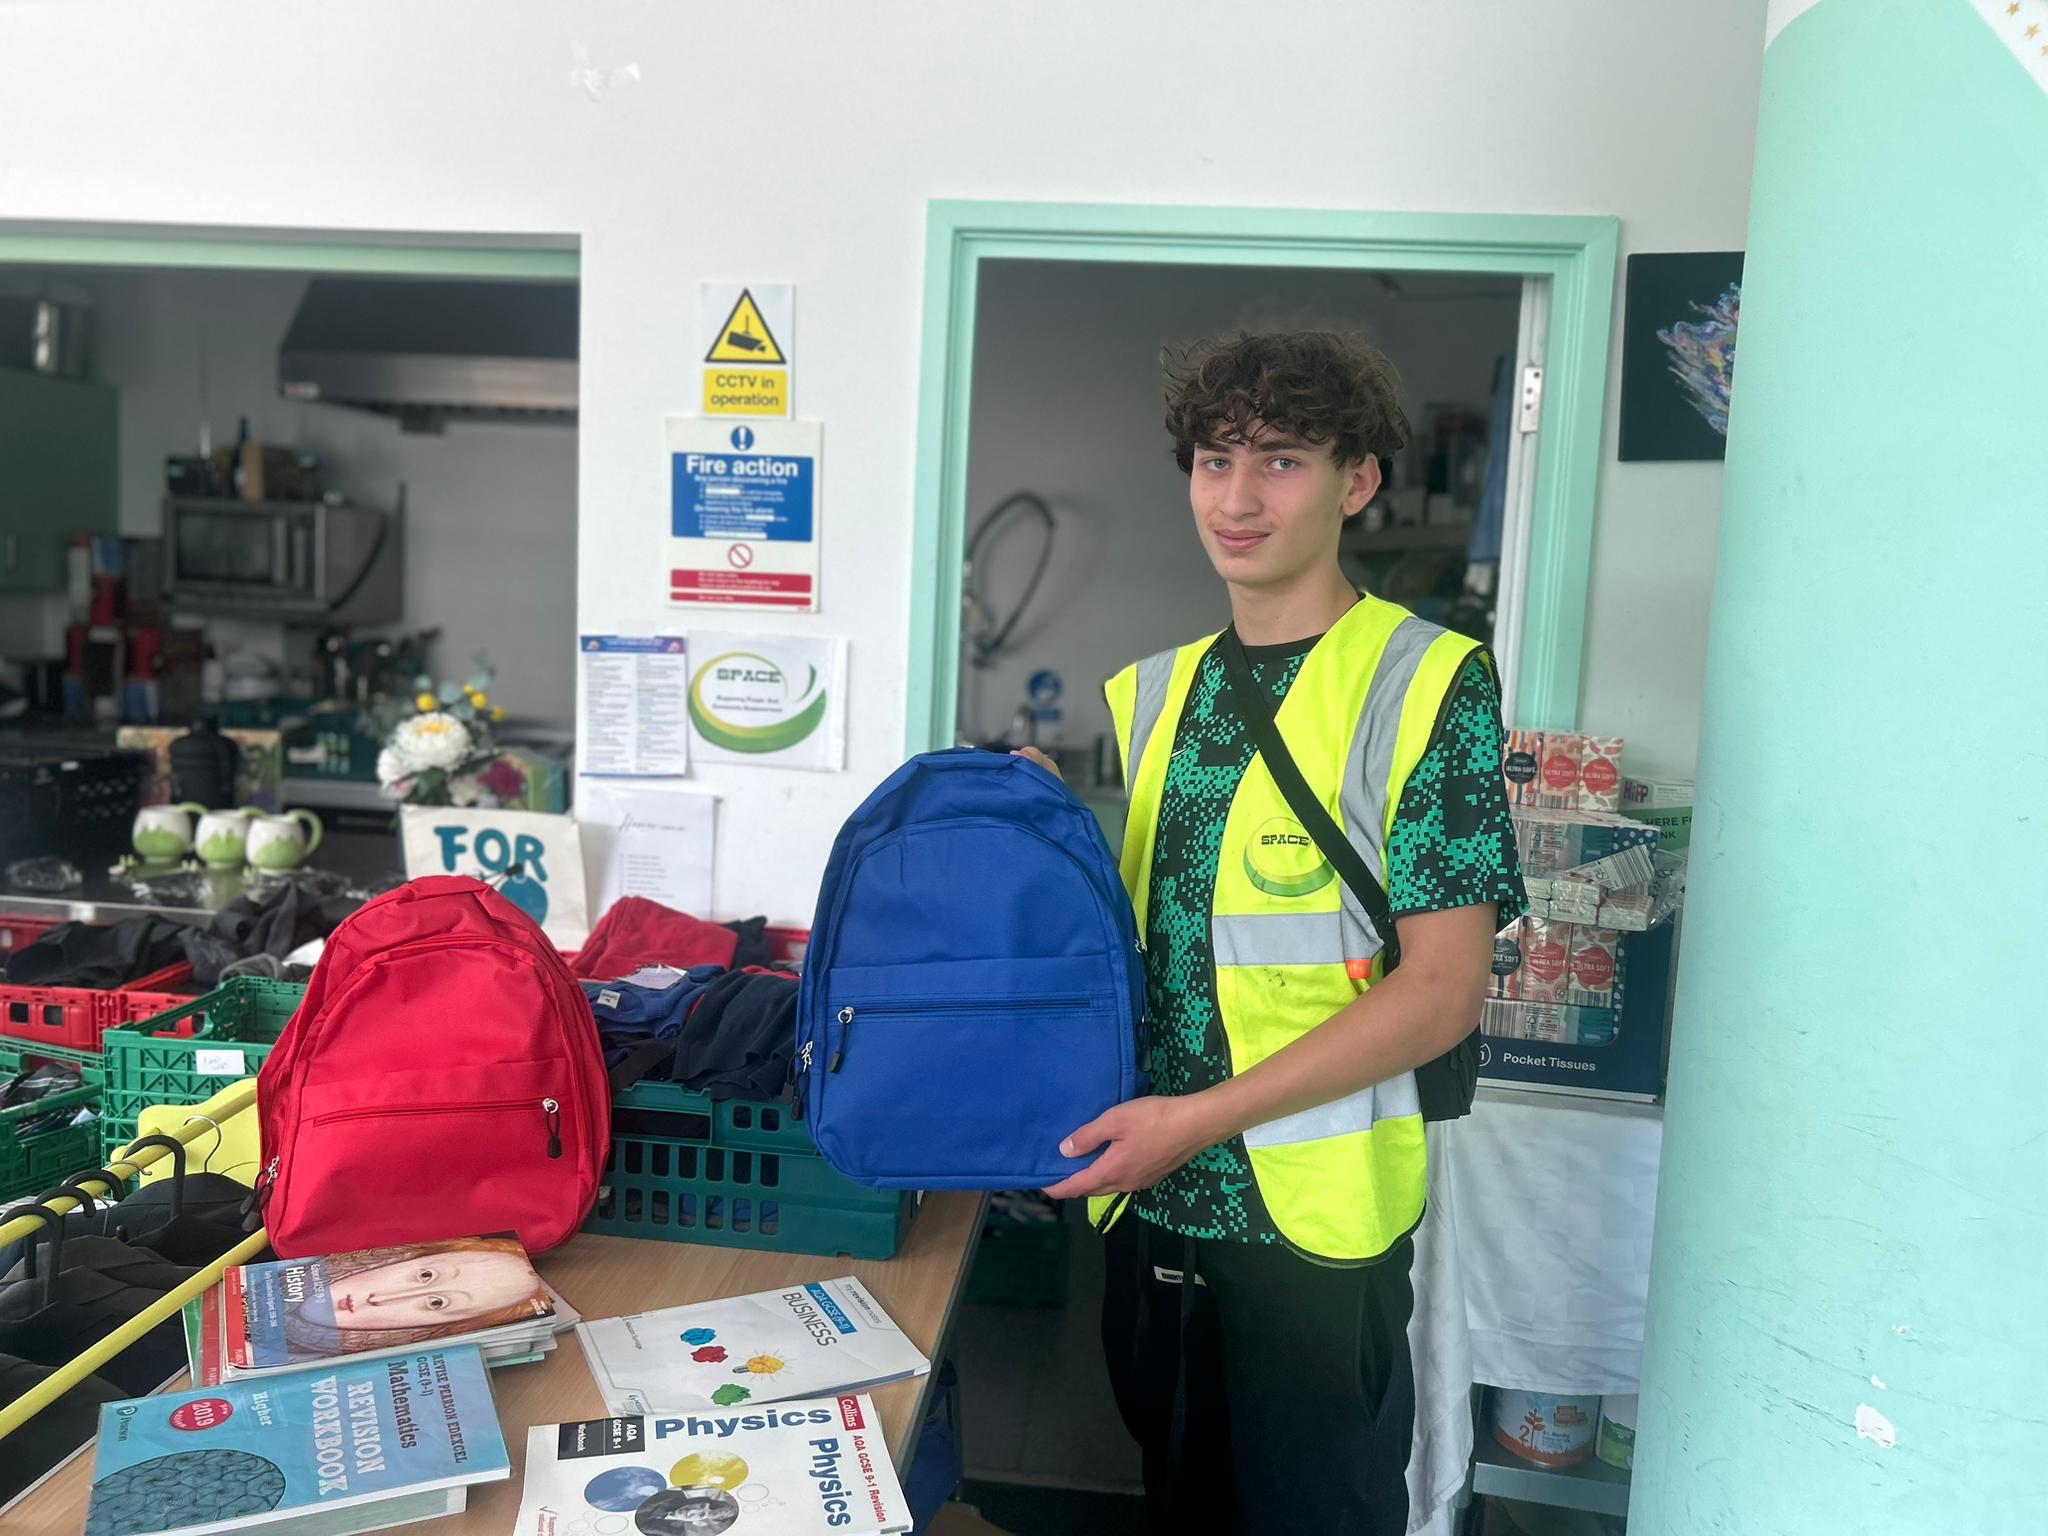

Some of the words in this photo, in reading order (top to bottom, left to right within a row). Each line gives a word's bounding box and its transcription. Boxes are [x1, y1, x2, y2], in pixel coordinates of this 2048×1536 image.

[715, 375, 757, 388] CCTV
[761, 376, 775, 388] in
[711, 393, 780, 407] operation
[686, 455, 727, 475] Fire
[732, 457, 799, 477] action
[717, 668, 782, 683] SPACE
[1261, 834, 1309, 847] SPACE
[1661, 831, 1676, 839] NK
[434, 826, 548, 882] FOR
[1504, 955, 1519, 963] SOFT
[1596, 964, 1610, 972] SOFT
[1503, 1052, 1546, 1067] Pocket
[1549, 1057, 1596, 1071] Tissues
[284, 1266, 305, 1302] History
[810, 1289, 822, 1302] AQA
[821, 1301, 841, 1318] GCSE
[851, 1290, 871, 1310] revision
[782, 1292, 838, 1346] BUSINESS
[416, 1356, 430, 1378] GCSE
[432, 1353, 449, 1383] REVISE
[418, 1379, 434, 1397] (9-1)
[192, 1401, 215, 1426] 2019
[251, 1391, 273, 1426] Higher
[388, 1359, 420, 1449] Mathematics
[438, 1385, 457, 1420] PEARSON
[841, 1399, 857, 1428] Collins
[119, 1416, 133, 1442] Pearson
[347, 1381, 386, 1474] REVISION
[612, 1418, 622, 1437] GCSE
[626, 1423, 637, 1442] AQA
[655, 1408, 832, 1440] Physics
[1518, 1425, 1530, 1443] 2
[310, 1375, 348, 1496] WORKBOOK
[447, 1421, 468, 1463] EDEXCEL
[612, 1438, 622, 1449] 9-1
[853, 1435, 866, 1451] AQA
[858, 1452, 873, 1473] GCSE
[809, 1438, 853, 1527] Physics
[865, 1474, 877, 1487] 9-1
[869, 1489, 886, 1523] Revision
